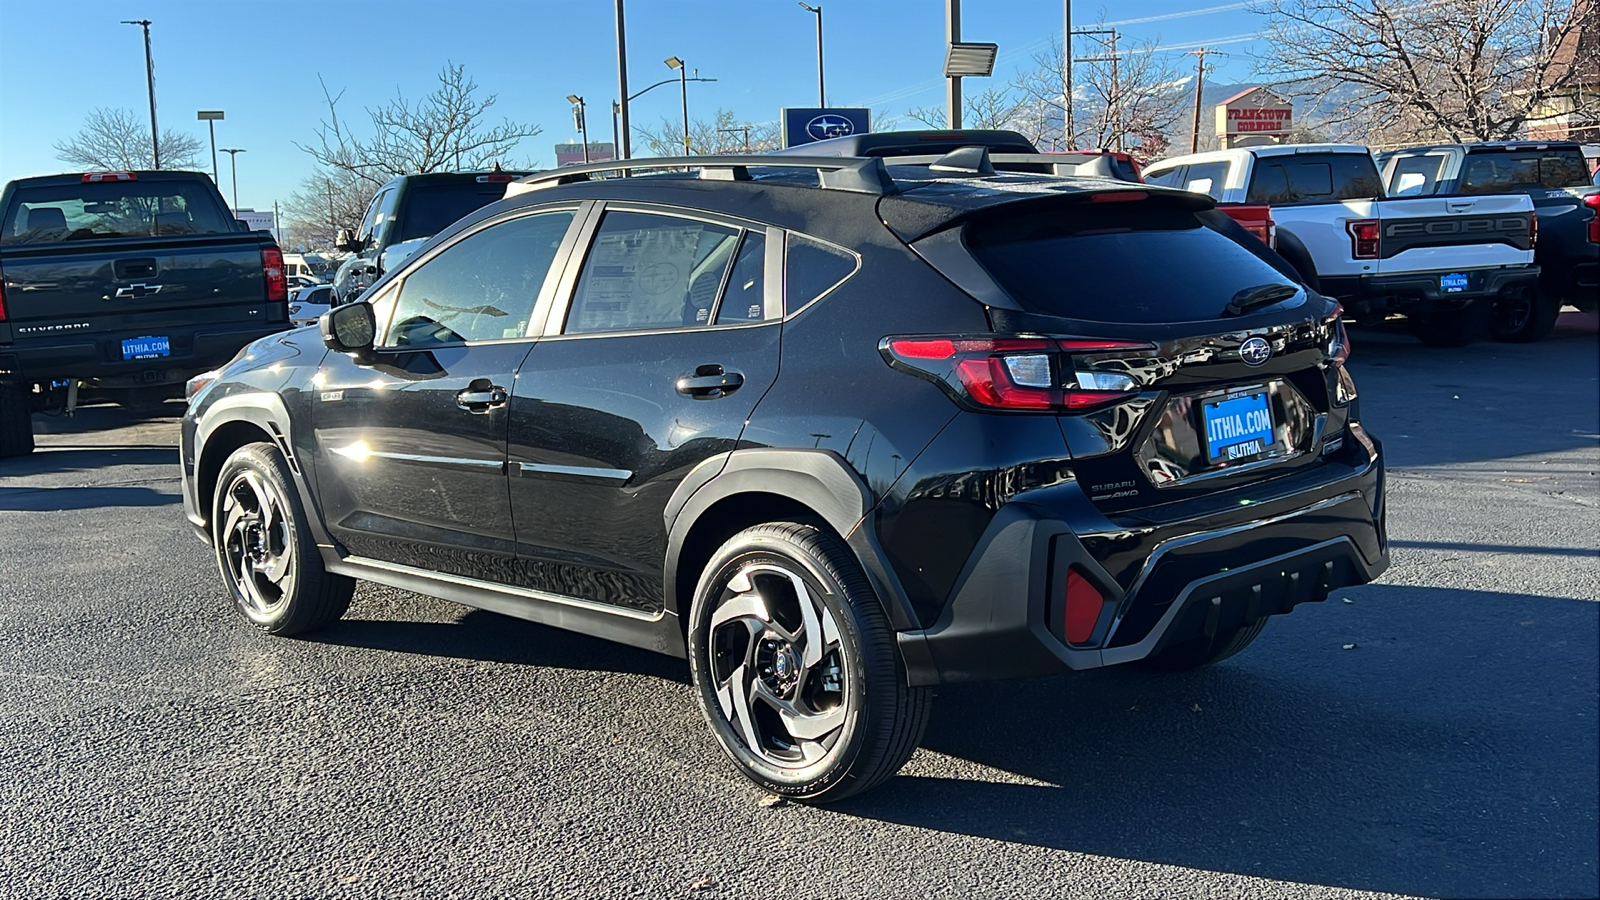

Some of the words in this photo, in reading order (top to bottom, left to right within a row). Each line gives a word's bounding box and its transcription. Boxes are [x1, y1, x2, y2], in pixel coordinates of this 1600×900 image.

[1228, 109, 1292, 120] FRANKTOWN
[1237, 121, 1282, 132] CORNERS
[564, 144, 604, 153] Atltis
[1386, 217, 1529, 238] FORD
[18, 322, 90, 333] SILVERADO
[122, 341, 170, 354] LITHIA.COM
[1236, 440, 1262, 457] LITHIA
[1091, 480, 1136, 492] SUBARU
[1111, 489, 1139, 499] AWD
